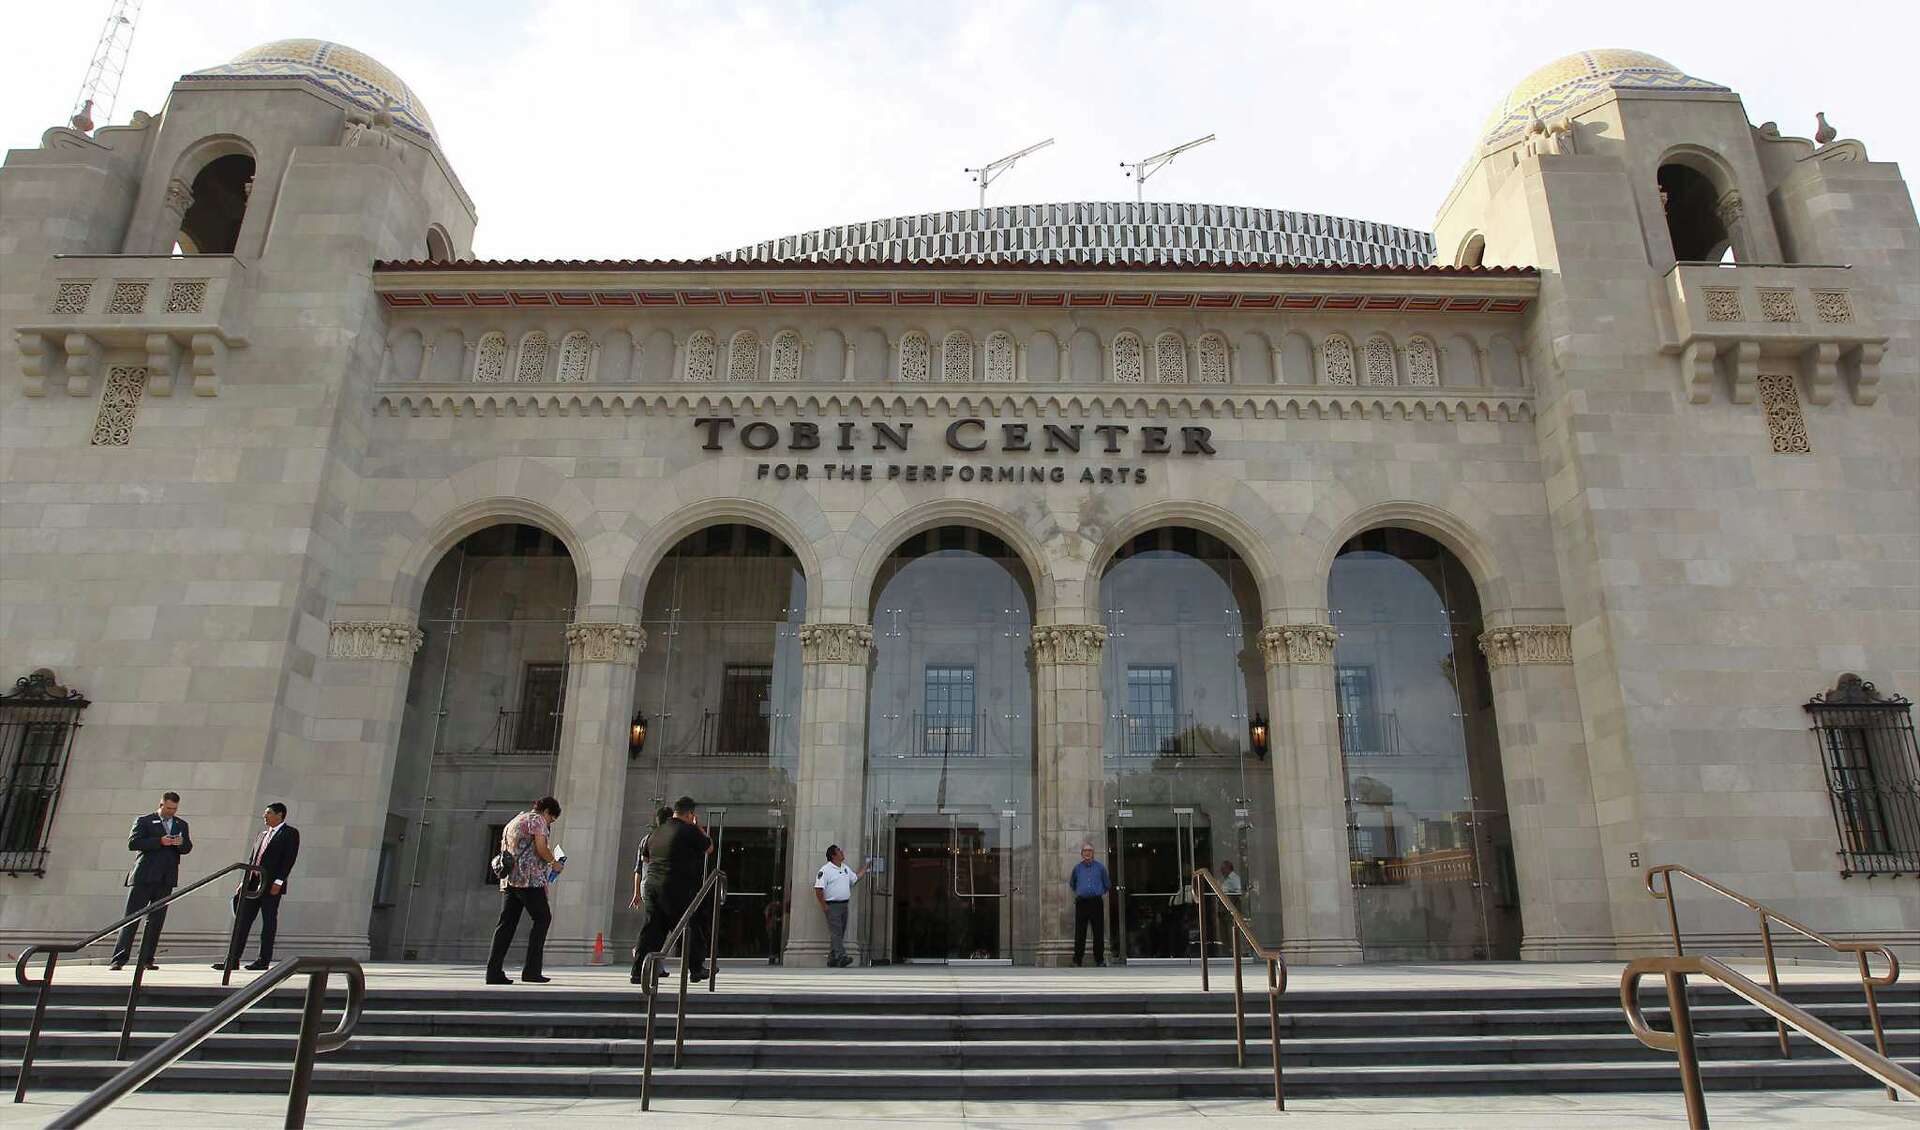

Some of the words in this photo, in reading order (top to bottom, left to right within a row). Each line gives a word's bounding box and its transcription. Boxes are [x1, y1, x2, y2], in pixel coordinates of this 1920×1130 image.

[694, 417, 912, 451] TOBIN
[946, 418, 1217, 454] CENTER
[758, 463, 809, 480] FOR
[824, 464, 873, 481] THE
[888, 465, 1065, 483] PERFORMING
[1080, 467, 1149, 484] ARTS
